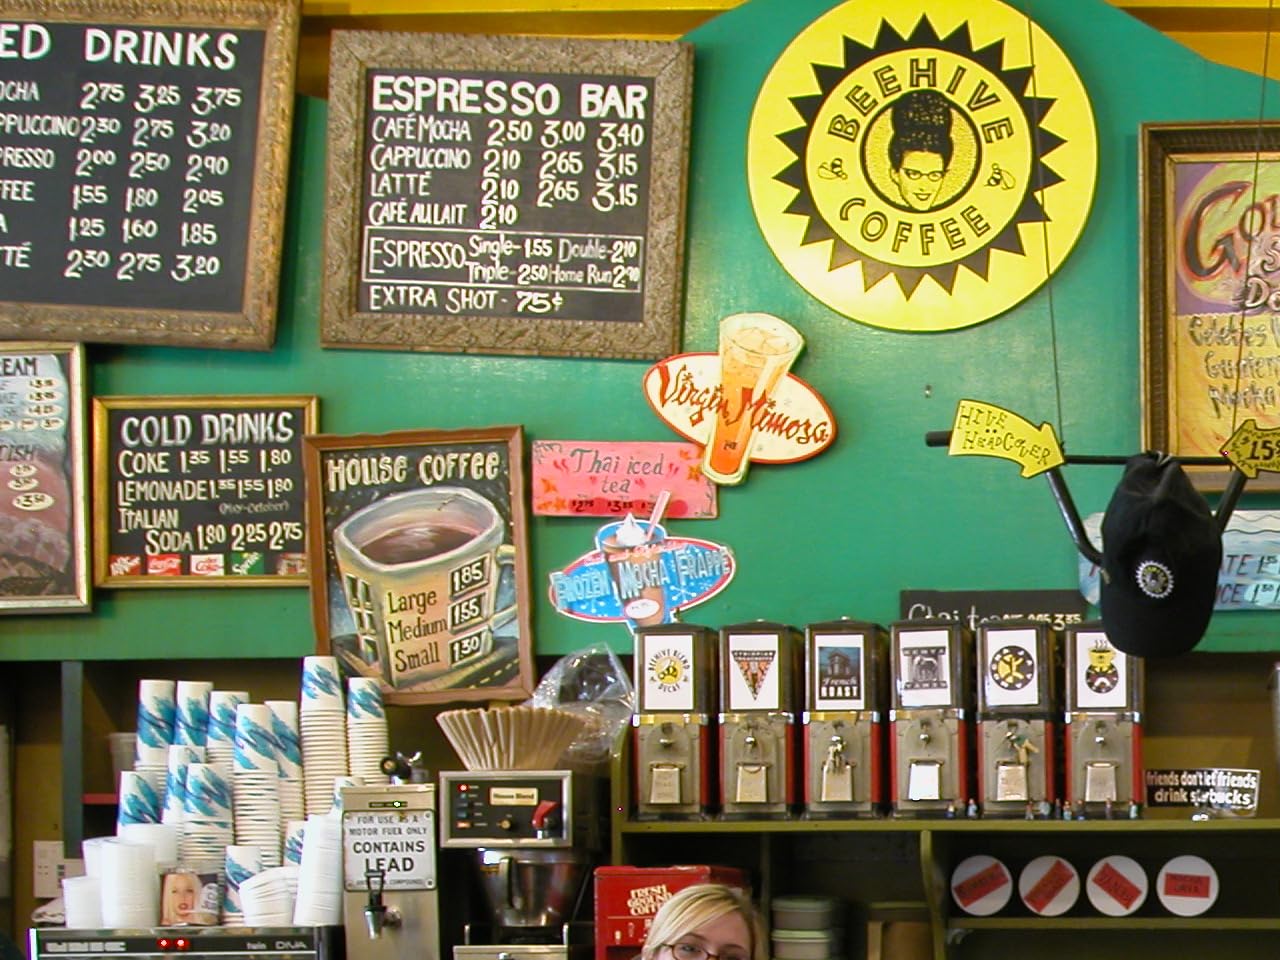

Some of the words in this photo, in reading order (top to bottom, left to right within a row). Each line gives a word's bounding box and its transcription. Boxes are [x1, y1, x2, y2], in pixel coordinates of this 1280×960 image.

[84, 28, 239, 70] DRINKS
[372, 75, 560, 115] ESPRESSO
[580, 83, 648, 119] BAR
[828, 58, 1014, 144] BEEHIVE
[419, 115, 472, 143] MOCHA
[370, 144, 471, 171] CAPPUCCINO
[840, 197, 991, 255] COFFEE
[369, 237, 467, 273] ESPRESSO
[587, 264, 612, 284] Run
[369, 286, 438, 310] EXTRA
[445, 288, 498, 313] SHOT
[659, 364, 728, 426] Virgin
[121, 415, 192, 447] COLD
[201, 412, 294, 445] DRINKS
[958, 405, 1008, 429] HIVE
[119, 451, 170, 478] COKE
[571, 449, 620, 474] Thai
[627, 454, 664, 475] iced
[118, 481, 207, 507] LEMONADE
[602, 477, 631, 493] tea
[145, 530, 194, 555] SODA
[618, 560, 670, 598] MOCHA
[388, 591, 438, 614] Large
[389, 619, 449, 645] Medium
[395, 643, 440, 673] Small
[821, 686, 858, 697] ROAST
[1147, 771, 1179, 785] friends
[1216, 771, 1257, 788] friends
[1154, 788, 1188, 802] drink
[349, 828, 378, 836] MOTOR
[406, 827, 427, 835] ONLY
[357, 816, 374, 824] FOR
[353, 840, 425, 854] CONTAINS
[365, 857, 415, 873] LEAD
